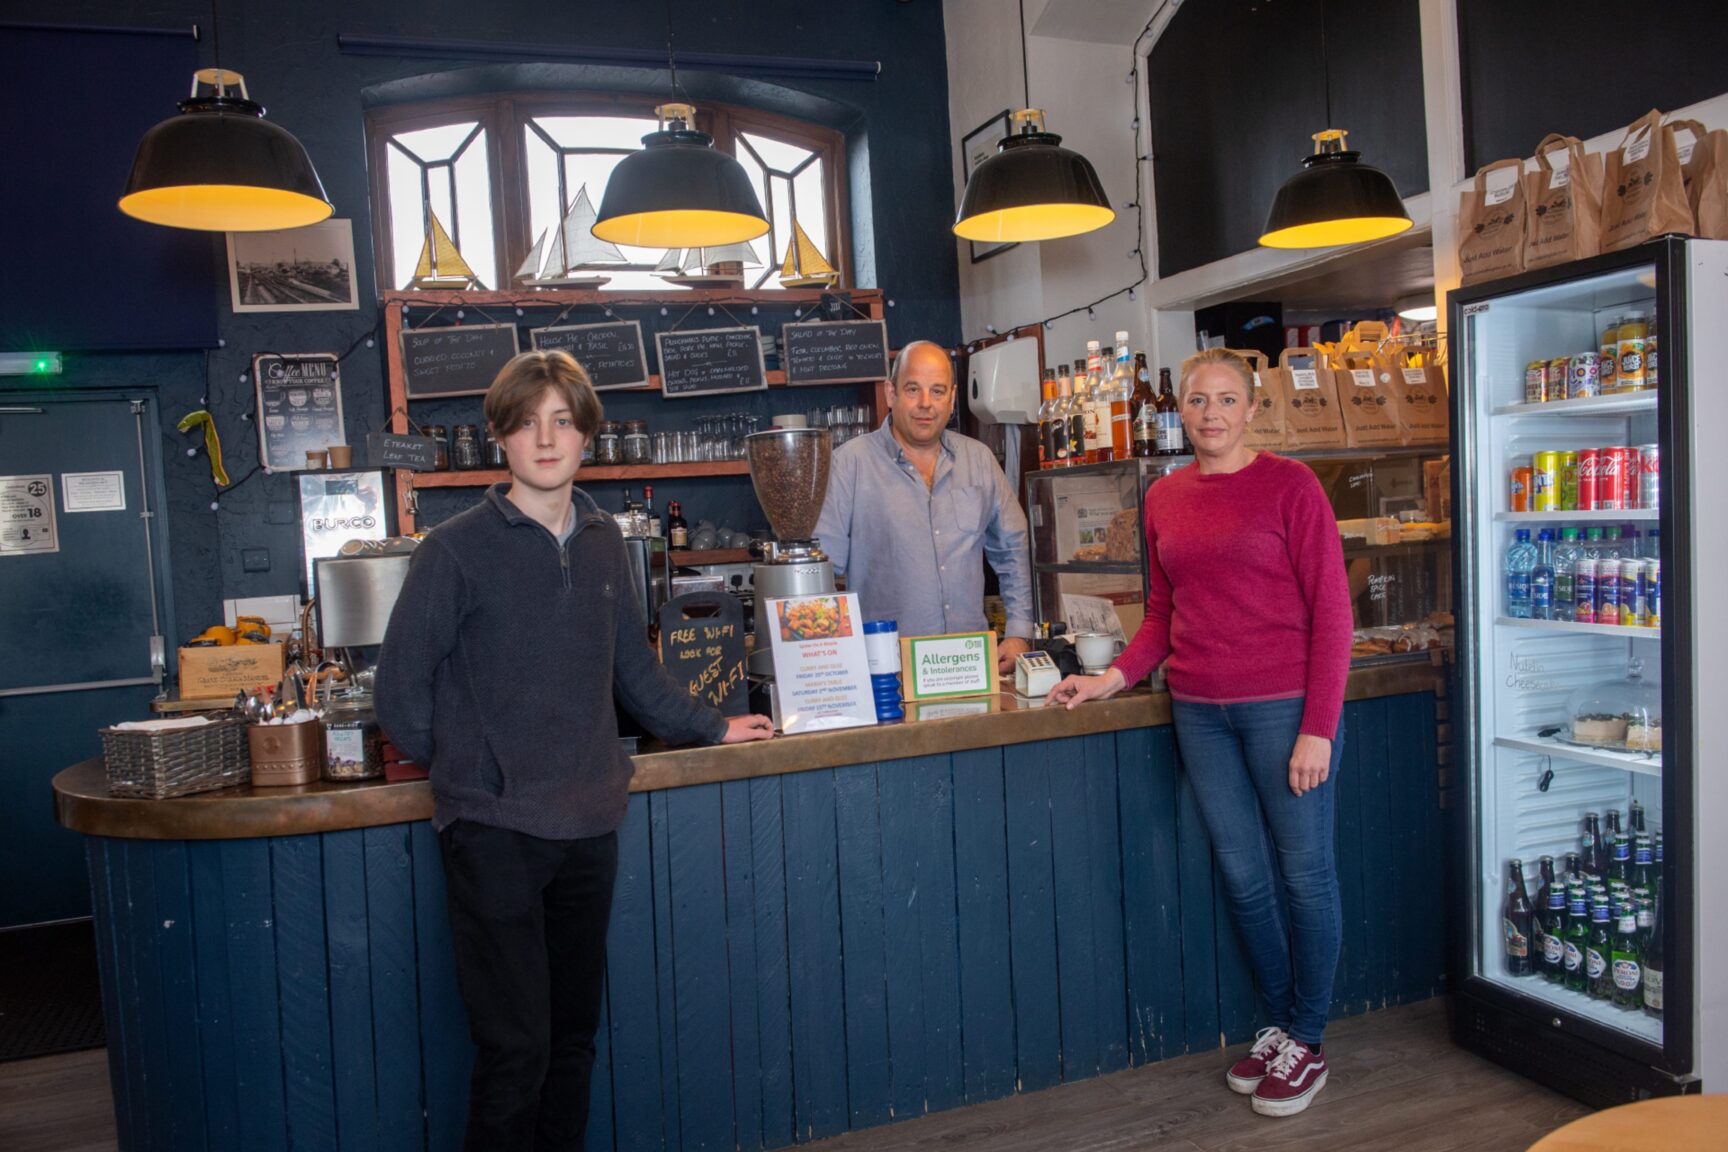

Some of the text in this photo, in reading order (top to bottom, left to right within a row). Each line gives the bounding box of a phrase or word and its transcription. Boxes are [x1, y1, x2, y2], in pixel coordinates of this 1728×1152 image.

[268, 362, 327, 384] Cffee MENU
[408, 453, 426, 462] TEA
[30, 482, 47, 495] 25
[28, 507, 42, 519] 18
[313, 516, 376, 532] BURCO
[670, 628, 696, 646] FREE
[680, 645, 723, 659] LOOK FOR
[922, 652, 980, 666] Allergens
[689, 655, 723, 697] GUEST
[922, 665, 977, 676] & Intolerances
